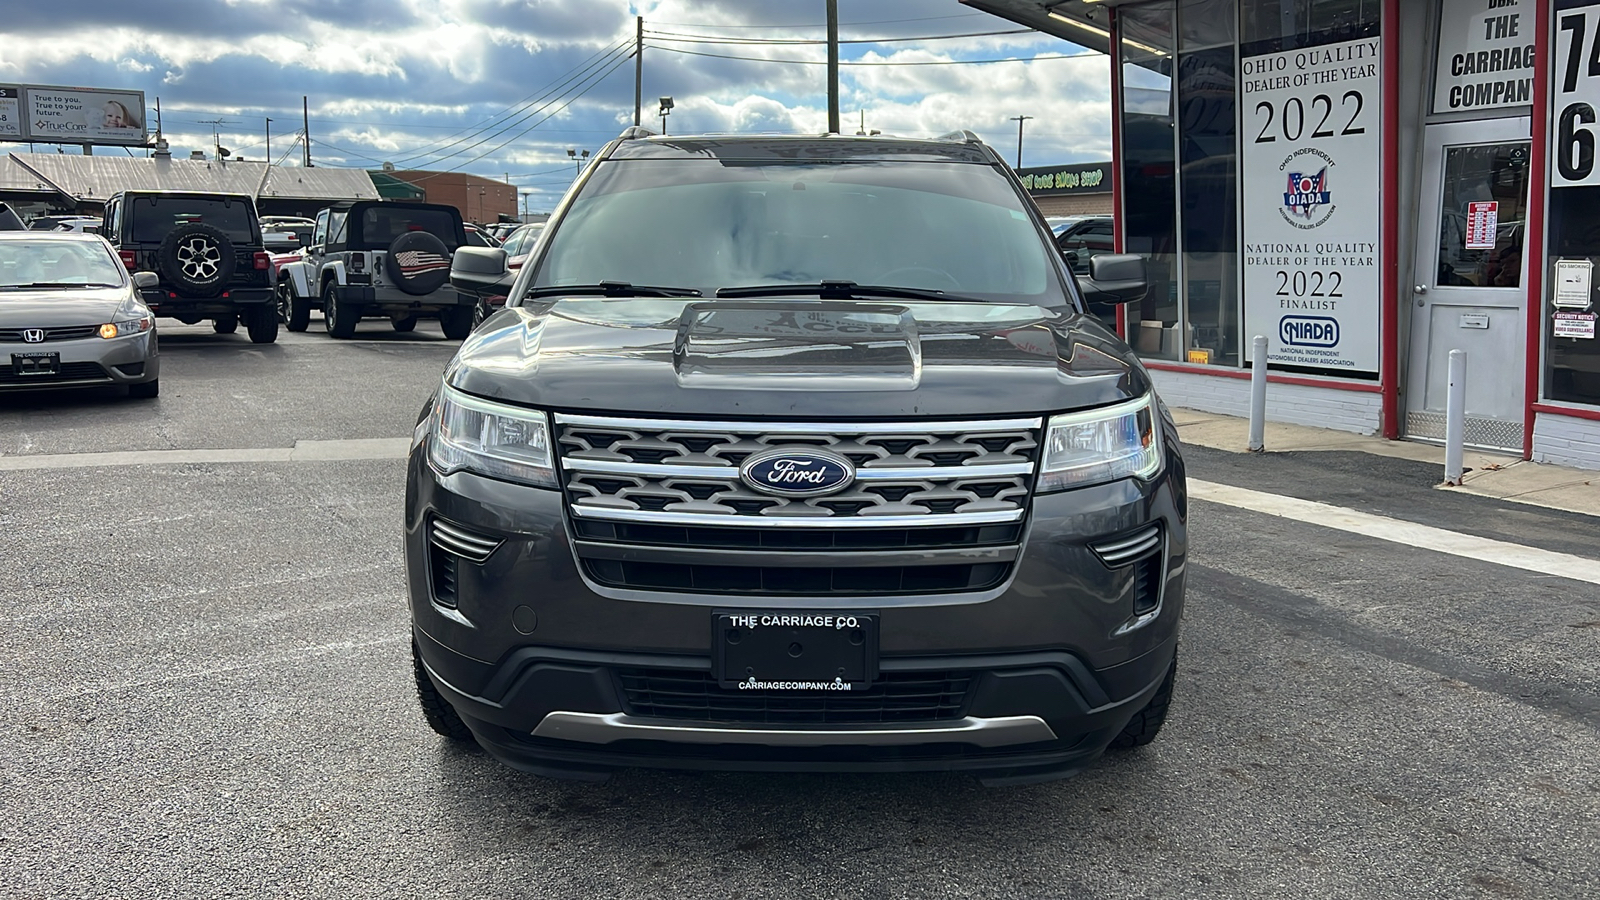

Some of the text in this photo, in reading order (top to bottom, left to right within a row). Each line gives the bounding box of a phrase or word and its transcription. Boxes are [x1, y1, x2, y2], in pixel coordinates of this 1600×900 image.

[1484, 13, 1519, 40] THE
[1243, 41, 1379, 75] OHIO QUALITY
[1451, 44, 1535, 77] CARRIAG
[1245, 76, 1290, 93] DEALER
[1293, 73, 1309, 87] OF
[1312, 69, 1337, 84] THE
[1341, 64, 1376, 80] YEAR
[1450, 78, 1534, 108] COMPAN
[36, 109, 63, 117] future.
[1255, 90, 1365, 144] 2022
[1279, 147, 1336, 171] OHIO INDEPENDENT
[1080, 168, 1103, 187] SHOP
[1289, 193, 1323, 205] OIADA
[1246, 243, 1376, 255] NATIONAL QUALITY
[1247, 256, 1374, 266] DEALER OF THE YEAR
[1275, 270, 1343, 298] 2022
[1280, 299, 1337, 311] FINALIST
[1284, 321, 1334, 341] NIADA
[1267, 354, 1355, 367] AUTOMOBILE DEALERS ASSOCIATION
[1305, 349, 1340, 357] INDEPENDENT
[767, 459, 827, 484] Ford
[730, 616, 860, 629] THE CARRIAGE CO.
[738, 681, 852, 691] CARRIAGECOMPANY.COM
